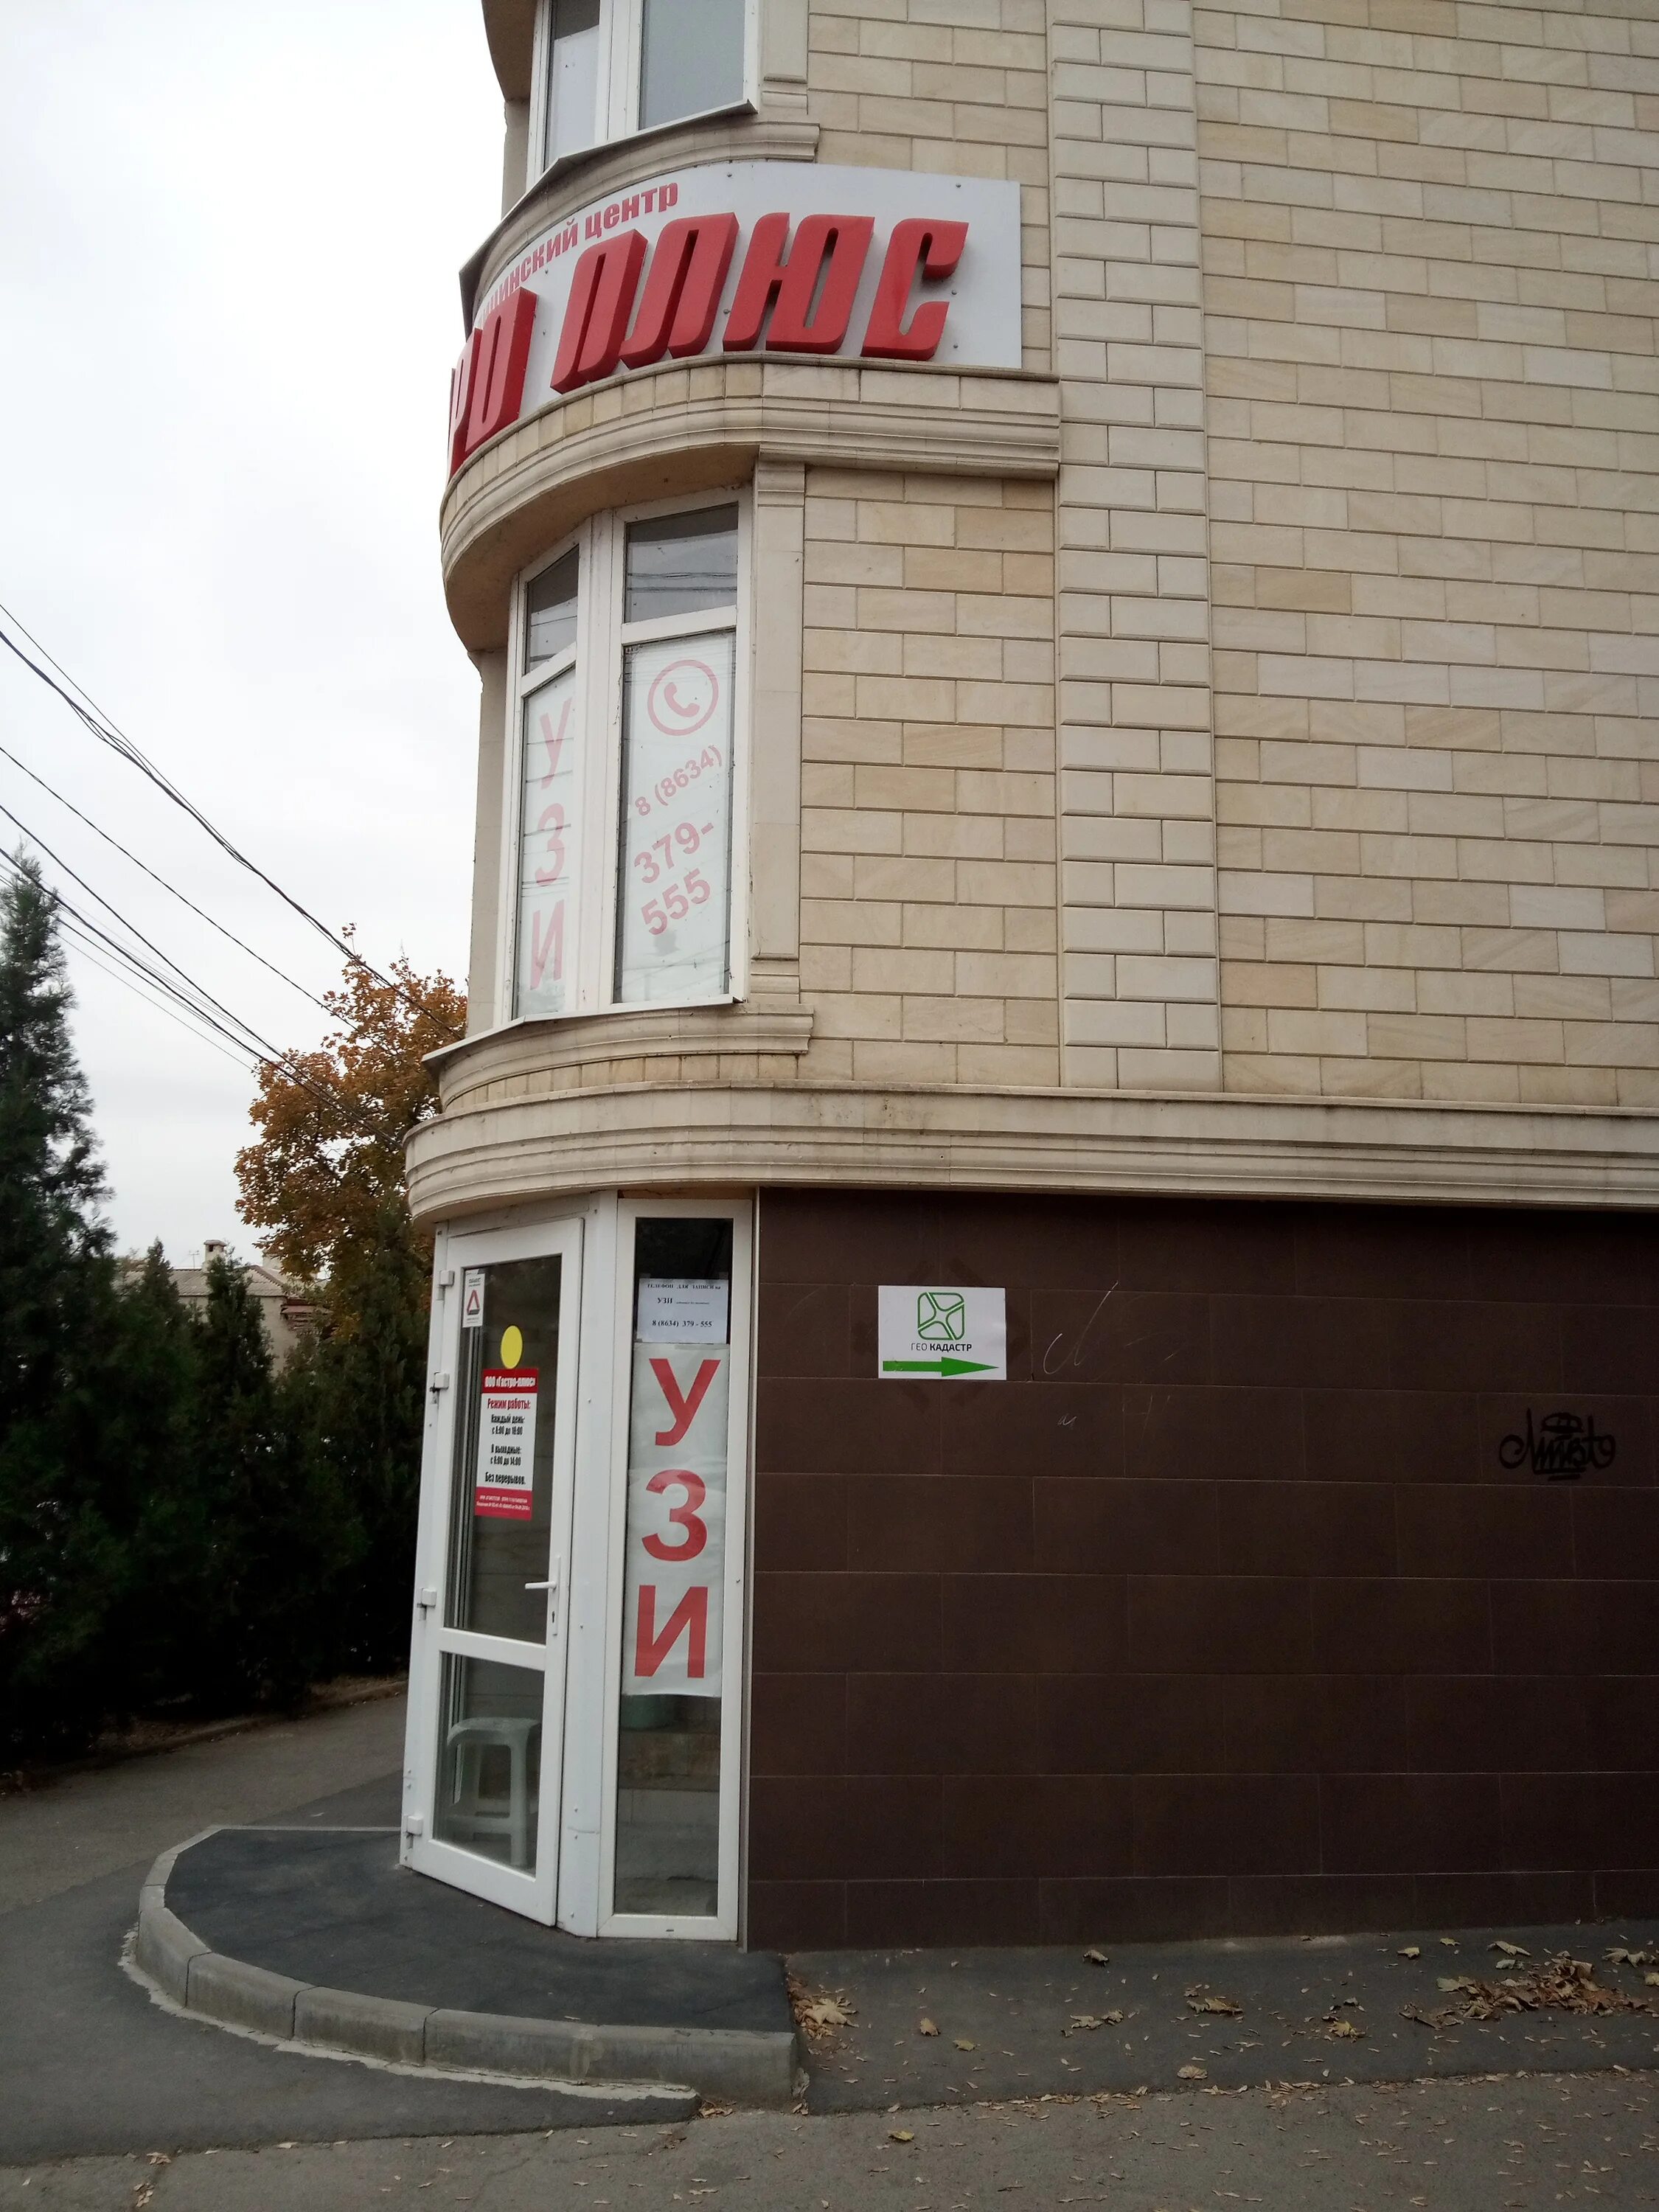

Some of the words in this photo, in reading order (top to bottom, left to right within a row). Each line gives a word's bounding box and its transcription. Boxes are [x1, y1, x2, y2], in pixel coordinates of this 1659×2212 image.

[585, 182, 679, 240] центр
[633, 796, 651, 817] 8
[655, 744, 724, 806] (8634)
[529, 697, 572, 990] УЗИ
[633, 821, 714, 884] 379-
[641, 867, 711, 936] 555
[911, 1343, 928, 1351] ГЕО
[930, 1343, 973, 1352] КАДАСТР
[487, 1398, 507, 1409] Режим
[485, 1471, 495, 1482] Без
[634, 1357, 722, 1679] УЗИ
